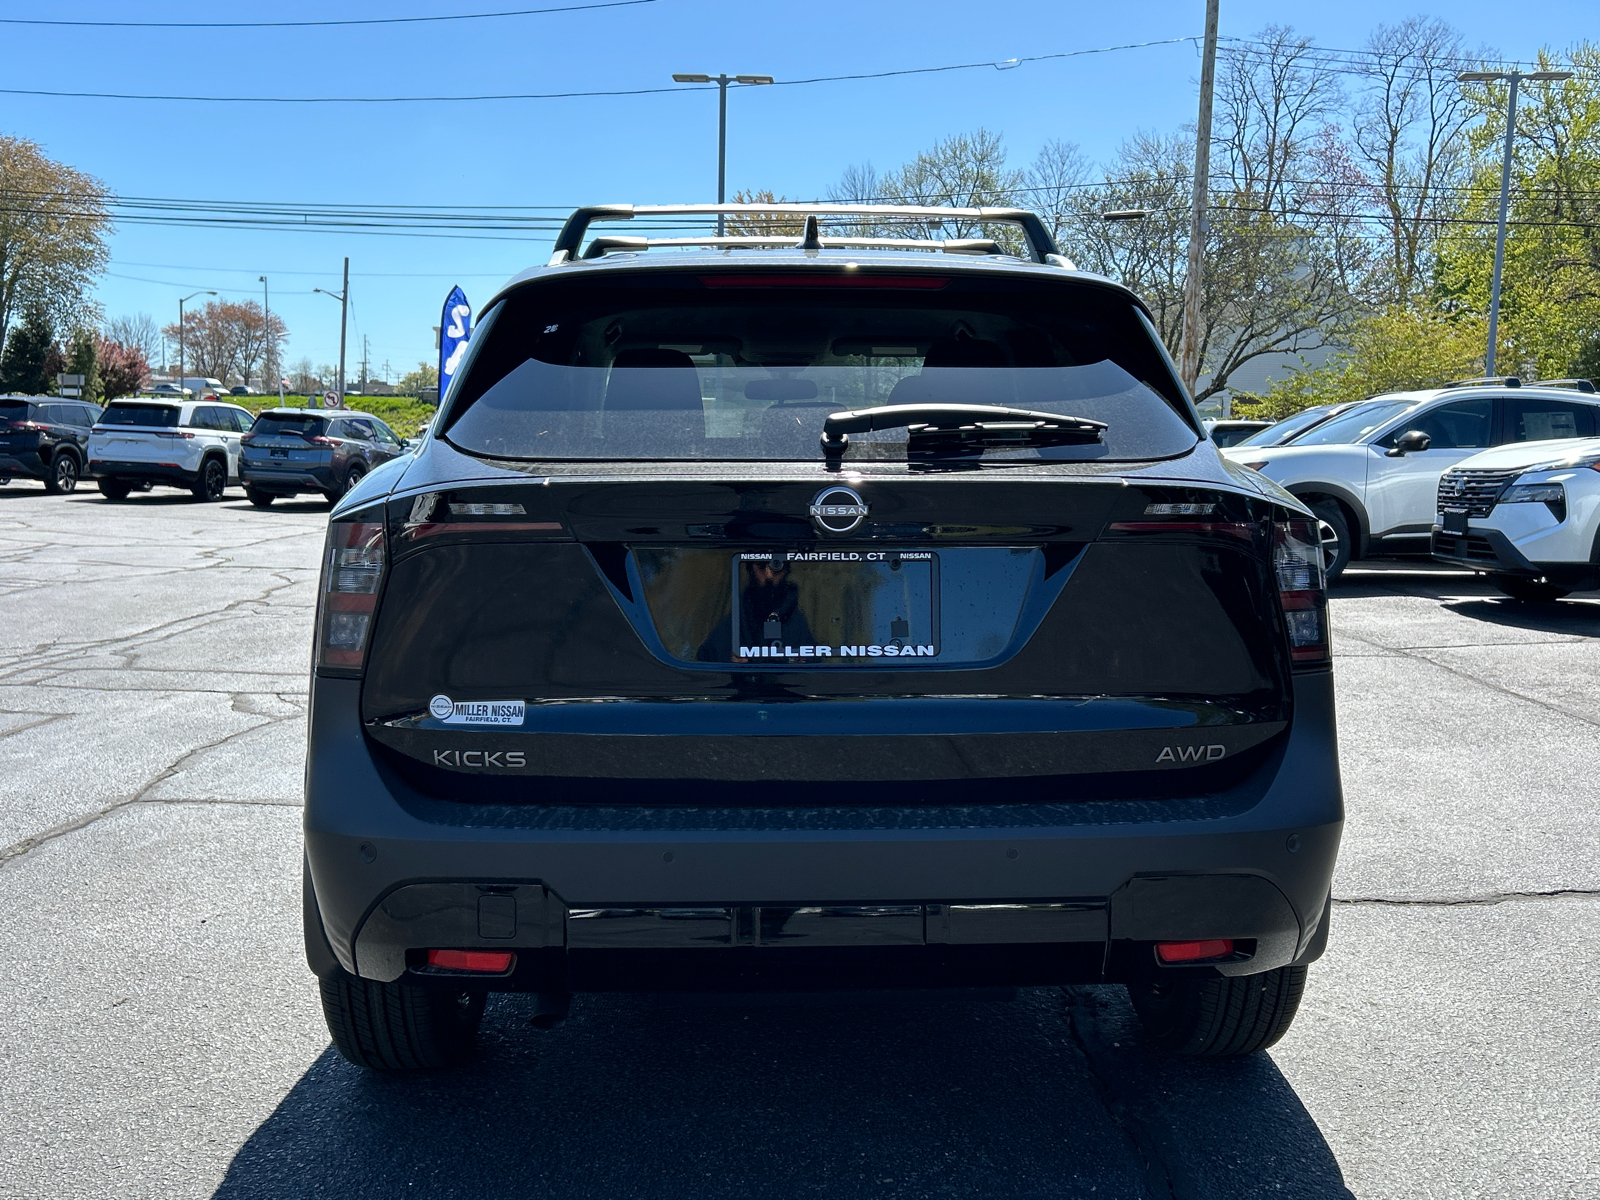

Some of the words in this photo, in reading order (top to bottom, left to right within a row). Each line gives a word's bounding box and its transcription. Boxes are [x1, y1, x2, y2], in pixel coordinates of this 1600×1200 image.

[811, 506, 868, 515] NISSAN
[786, 552, 863, 562] FAIRFIELD,
[866, 552, 886, 561] CT
[740, 645, 832, 657] MILLER
[840, 645, 934, 656] NISSAN
[455, 704, 488, 716] MILLER
[491, 704, 524, 718] NISSAN
[433, 749, 527, 768] KICKS
[1155, 744, 1226, 763] AWD
